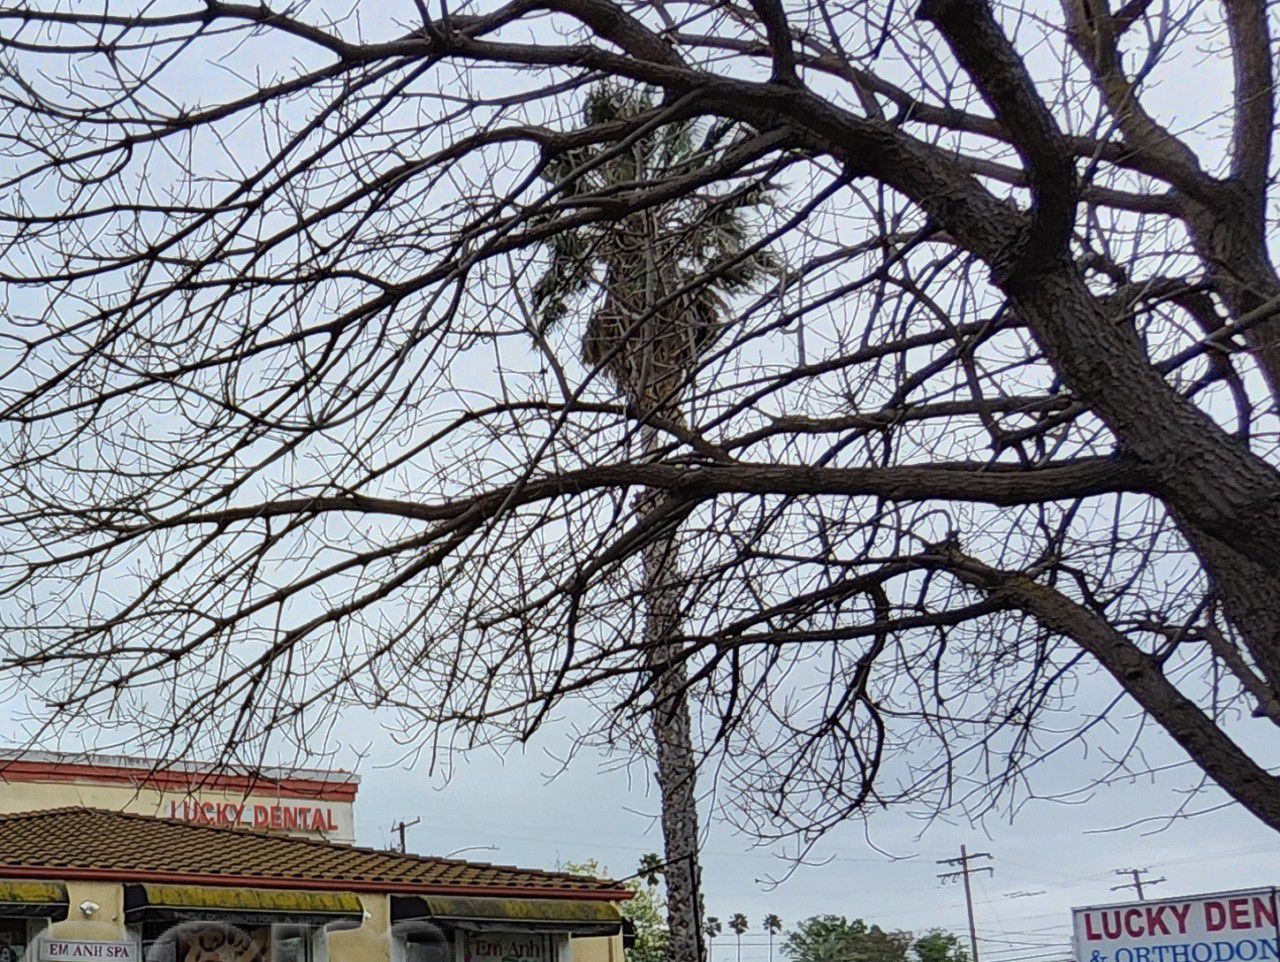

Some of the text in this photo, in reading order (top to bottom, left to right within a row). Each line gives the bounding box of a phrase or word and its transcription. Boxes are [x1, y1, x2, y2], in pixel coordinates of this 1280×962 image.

[171, 799, 338, 831] LUCKY DENTAL
[1084, 904, 1191, 941] LUCKY
[73, 945, 102, 957] ANH
[106, 946, 129, 958] SPA
